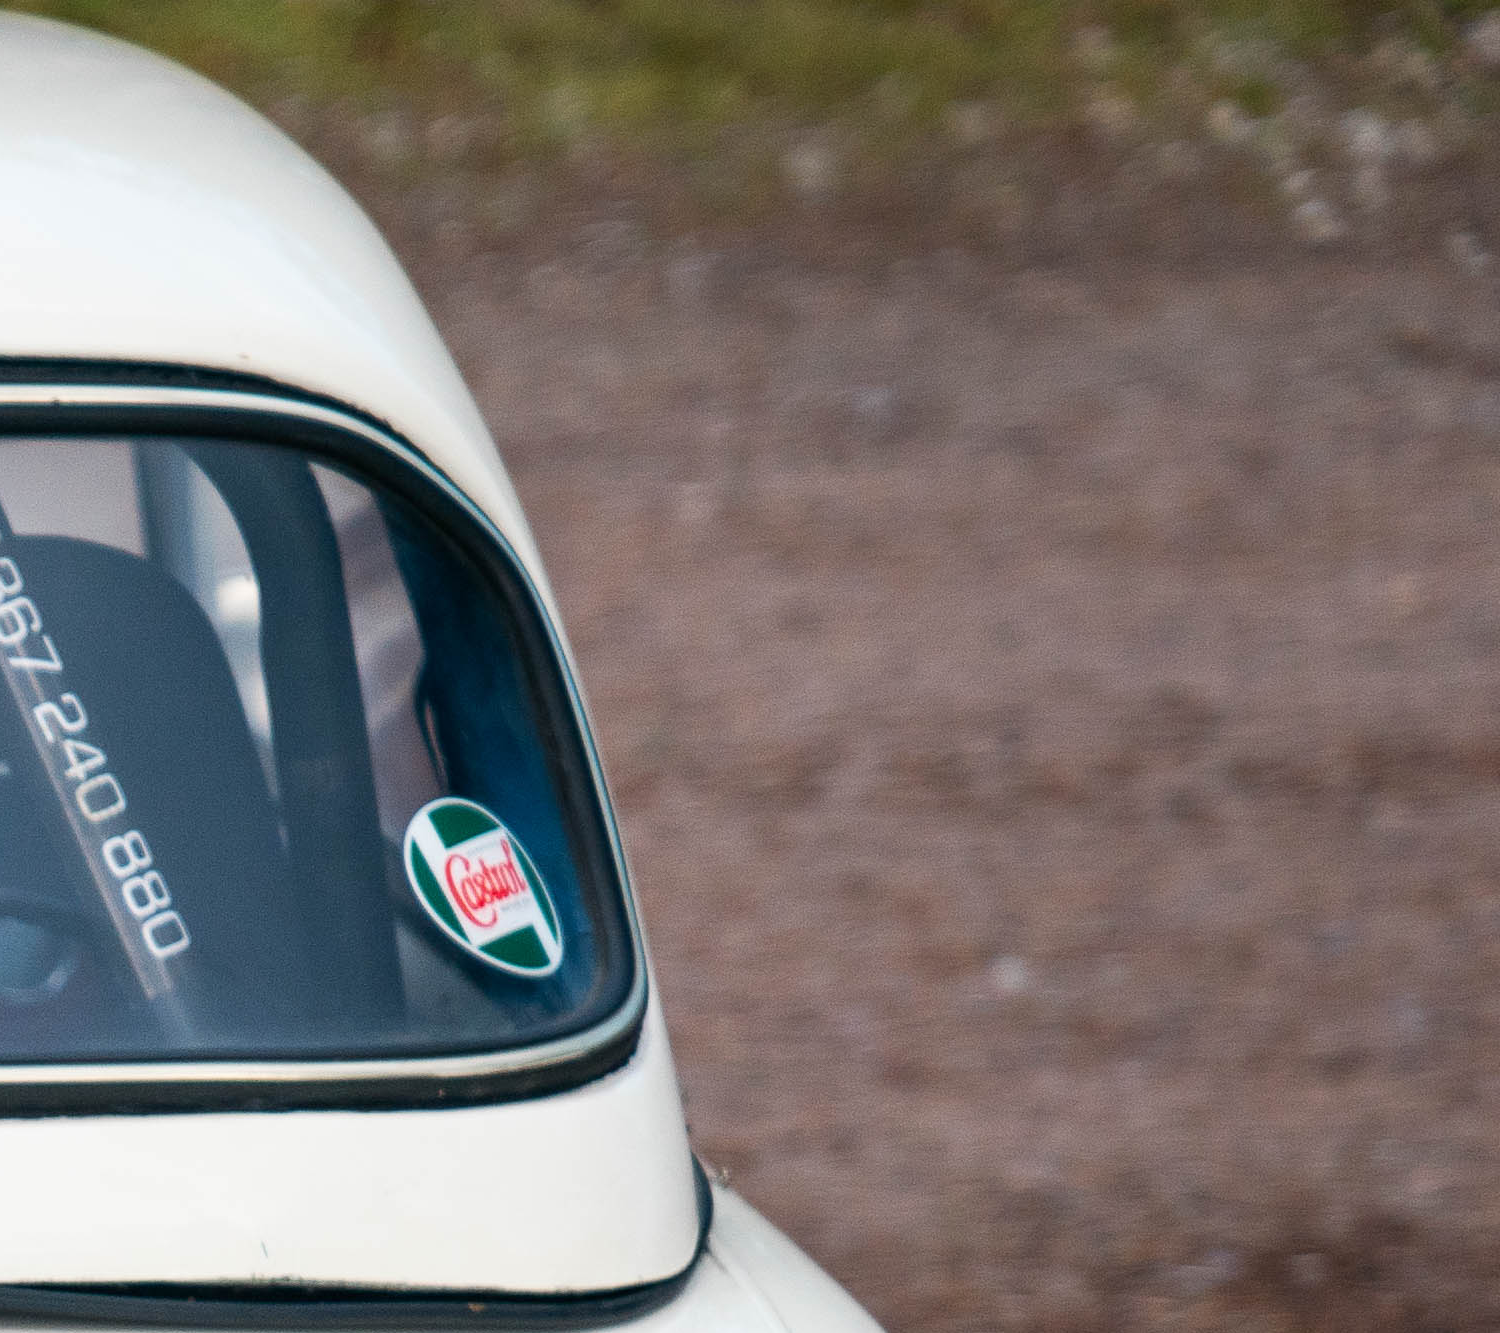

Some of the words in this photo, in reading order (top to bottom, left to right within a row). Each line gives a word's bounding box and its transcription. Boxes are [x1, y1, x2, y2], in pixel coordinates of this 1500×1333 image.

[33, 692, 127, 822] 240
[101, 829, 192, 959] 880
[445, 834, 527, 928] Castrol
